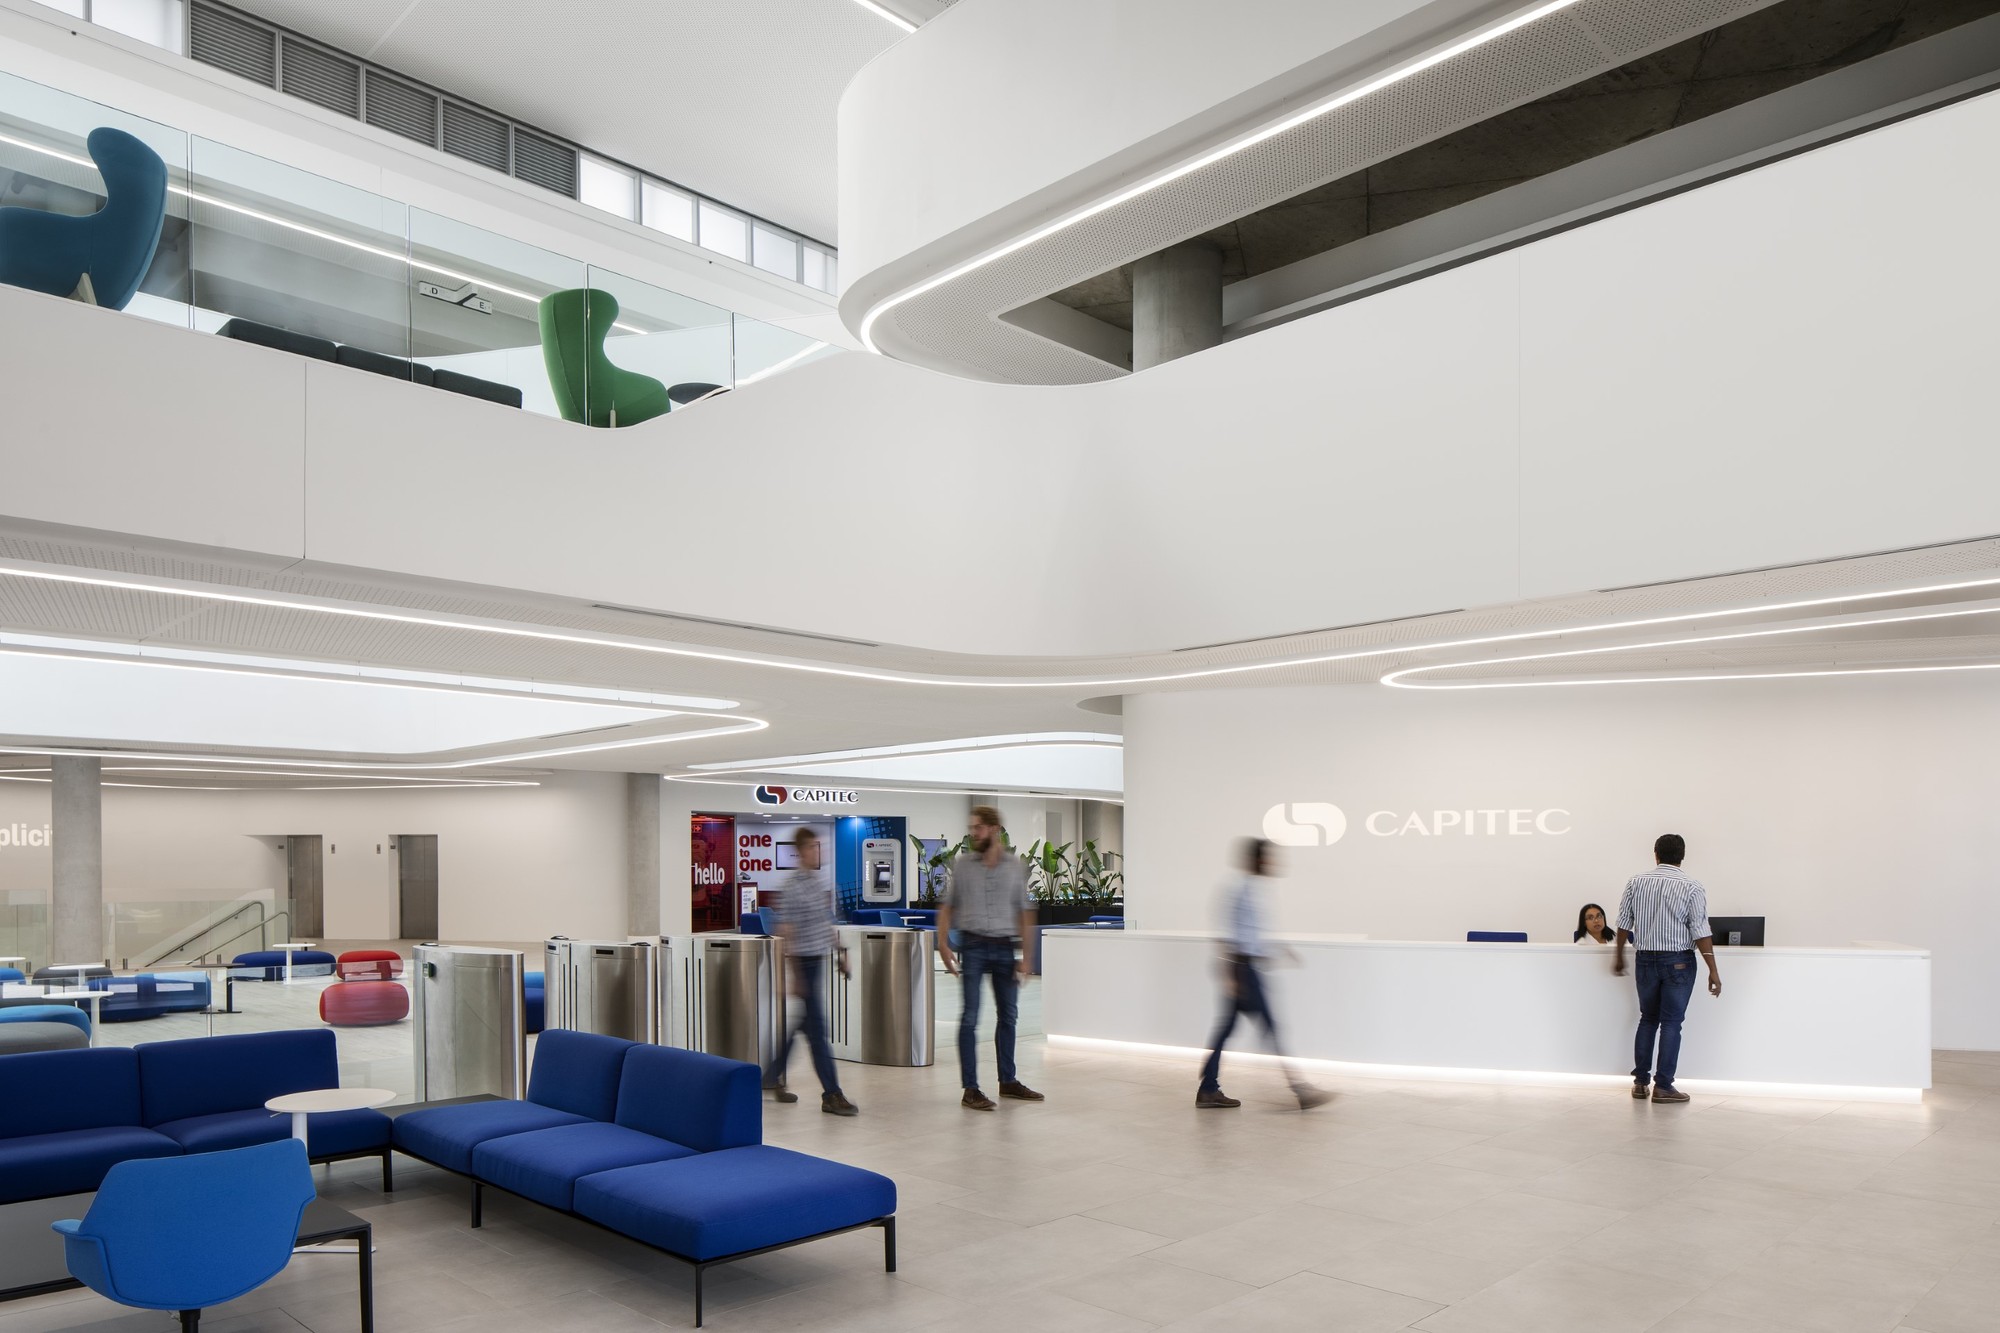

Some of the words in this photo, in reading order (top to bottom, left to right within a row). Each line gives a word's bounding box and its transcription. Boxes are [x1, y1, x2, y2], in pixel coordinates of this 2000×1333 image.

[793, 789, 859, 803] CAPITEC
[1365, 808, 1571, 836] CAPITEC
[0, 823, 53, 852] plici
[739, 834, 772, 847] one
[739, 848, 750, 857] to
[739, 858, 772, 871] one
[694, 862, 725, 885] hello
